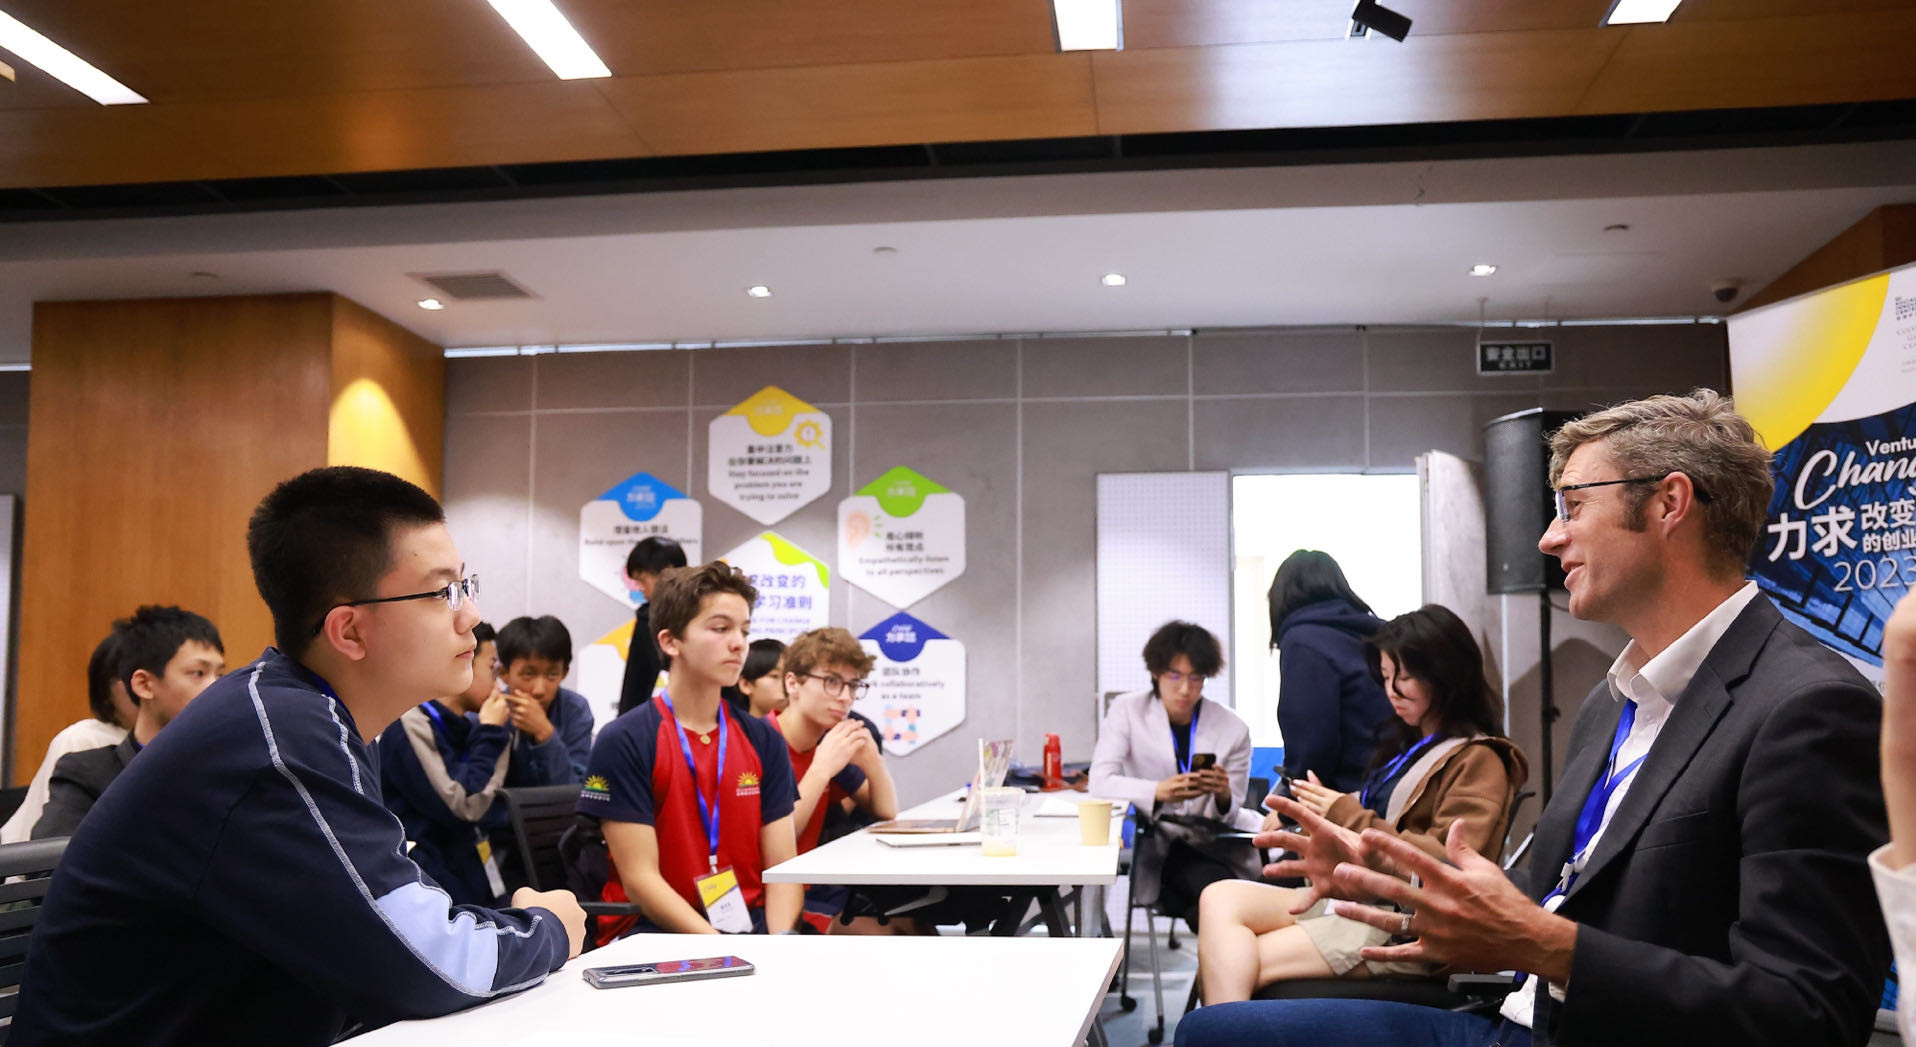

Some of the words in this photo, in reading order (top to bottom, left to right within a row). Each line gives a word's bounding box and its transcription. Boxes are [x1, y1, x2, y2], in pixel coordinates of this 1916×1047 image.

[1486, 346, 1546, 361] 安全出口
[1865, 436, 1916, 457] Ventu
[1860, 498, 1916, 531] 改变
[1768, 505, 1858, 563] 力求
[1863, 528, 1916, 553] 的创业
[1833, 556, 1916, 592] 2023
